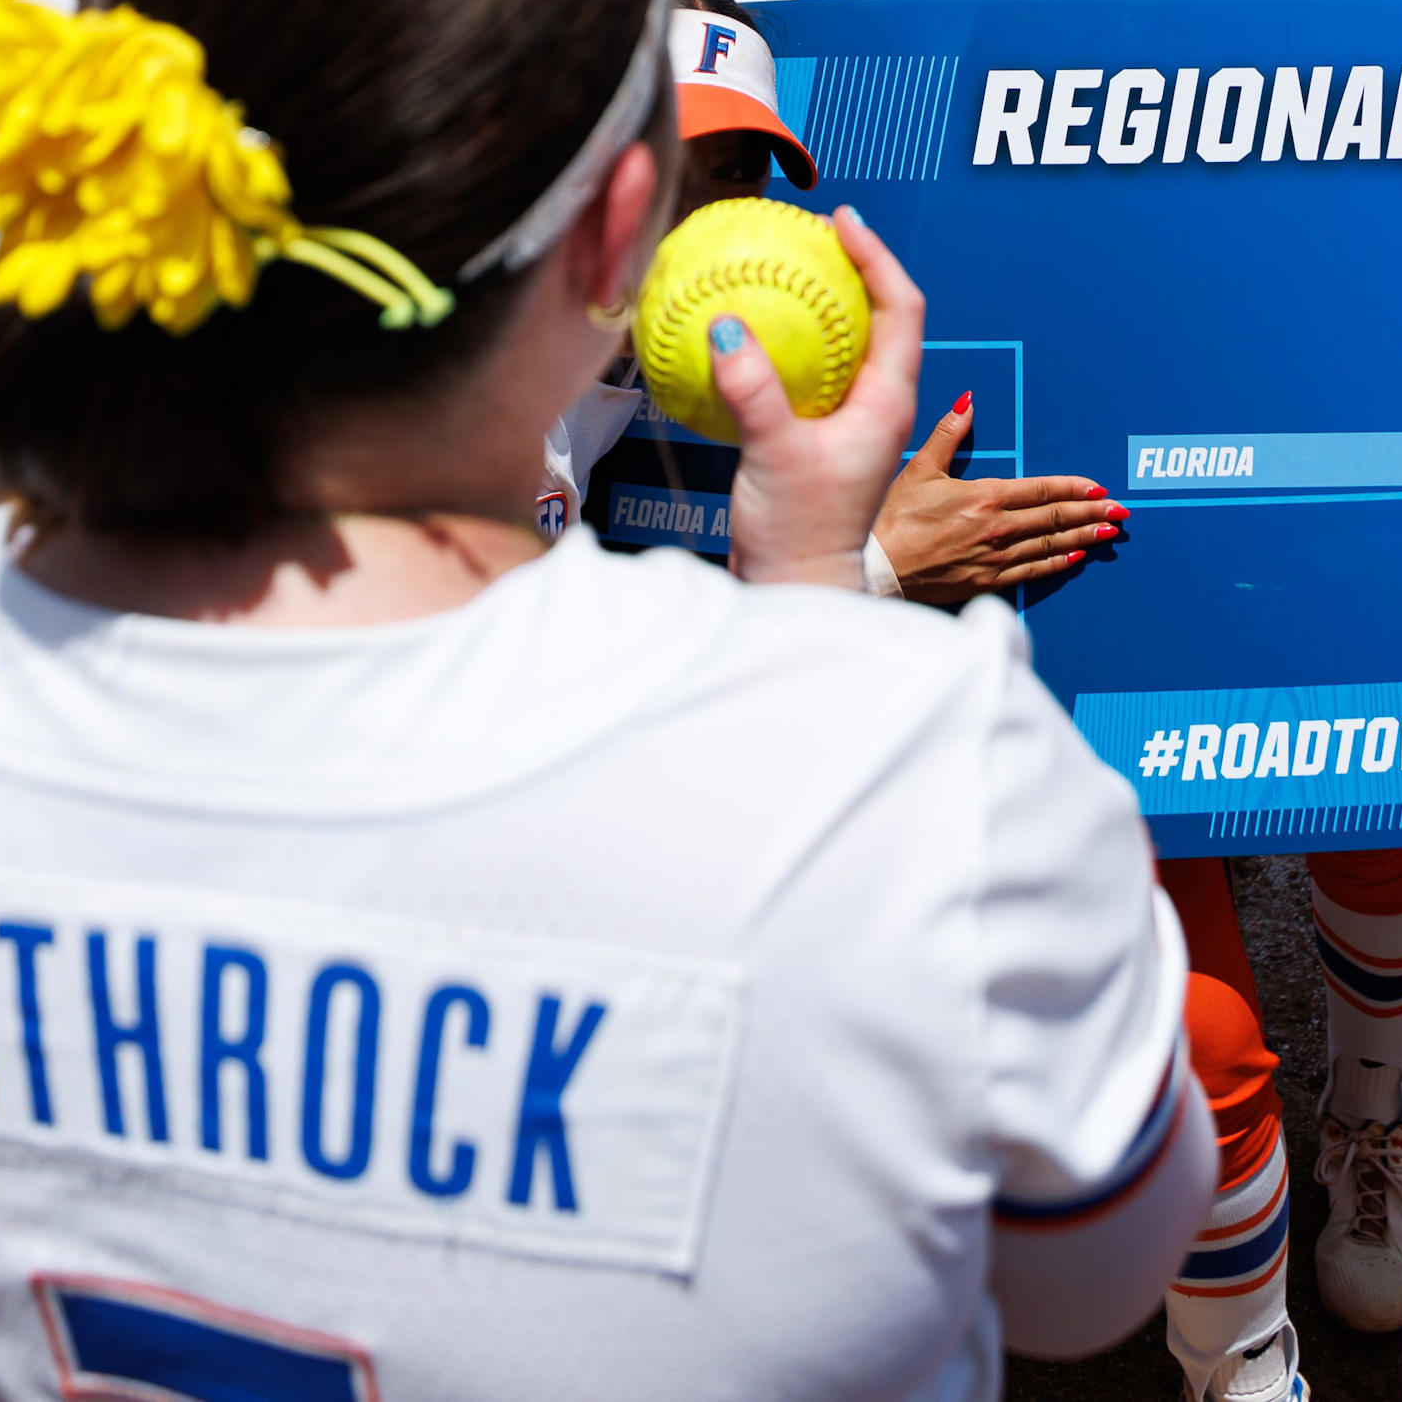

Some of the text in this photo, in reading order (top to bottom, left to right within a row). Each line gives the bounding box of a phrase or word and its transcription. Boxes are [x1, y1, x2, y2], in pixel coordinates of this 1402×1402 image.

[692, 22, 737, 75] F
[1136, 446, 1254, 478] FLORIDA
[614, 496, 705, 535] FLORIDA
